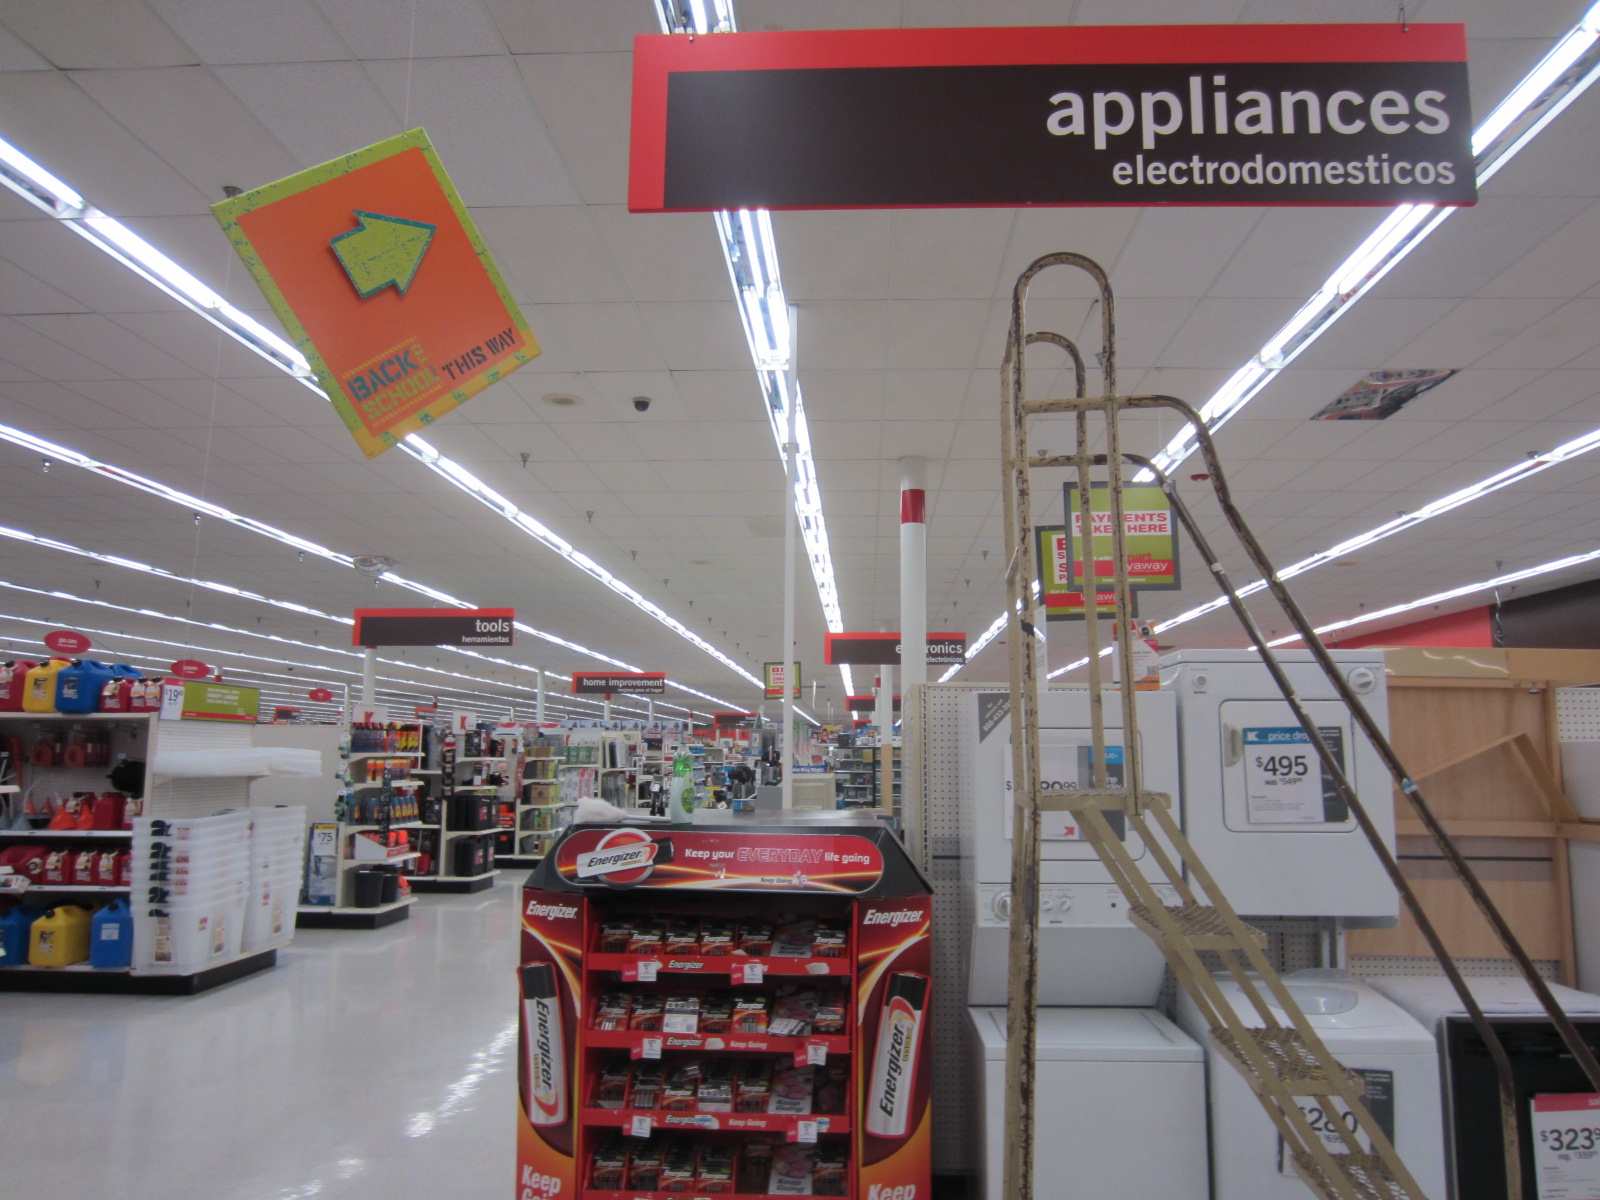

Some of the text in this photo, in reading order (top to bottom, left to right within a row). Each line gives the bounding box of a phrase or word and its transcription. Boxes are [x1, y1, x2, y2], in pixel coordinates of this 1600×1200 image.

[1046, 75, 1451, 150] appliances
[1112, 153, 1456, 185] electrodomesticos
[441, 327, 516, 381] THIS WAY
[346, 348, 419, 402] BACK
[360, 366, 441, 420] SCHOOL
[1075, 512, 1168, 523] PAYENTS
[1127, 523, 1168, 533] HERE
[475, 619, 510, 632] tools
[461, 635, 510, 643] herramientas
[895, 642, 963, 654] eronics
[583, 677, 663, 688] home improvement
[1268, 731, 1291, 742] price
[1255, 755, 1308, 776] $495
[586, 849, 643, 869] Energizer
[685, 847, 871, 865] Keep your EVERYDAY life going
[760, 876, 793, 885] Keep Going
[526, 900, 579, 920] Energizer
[863, 908, 925, 928] Energizer
[668, 960, 704, 971] Energizer
[536, 998, 554, 1090] Energizer
[667, 1037, 703, 1048] Energizer
[730, 1040, 747, 1049] Keep
[748, 1041, 768, 1050] Going
[880, 1023, 905, 1117] Energizer
[521, 1164, 562, 1197] Keep
[867, 1183, 917, 1200] Keep
